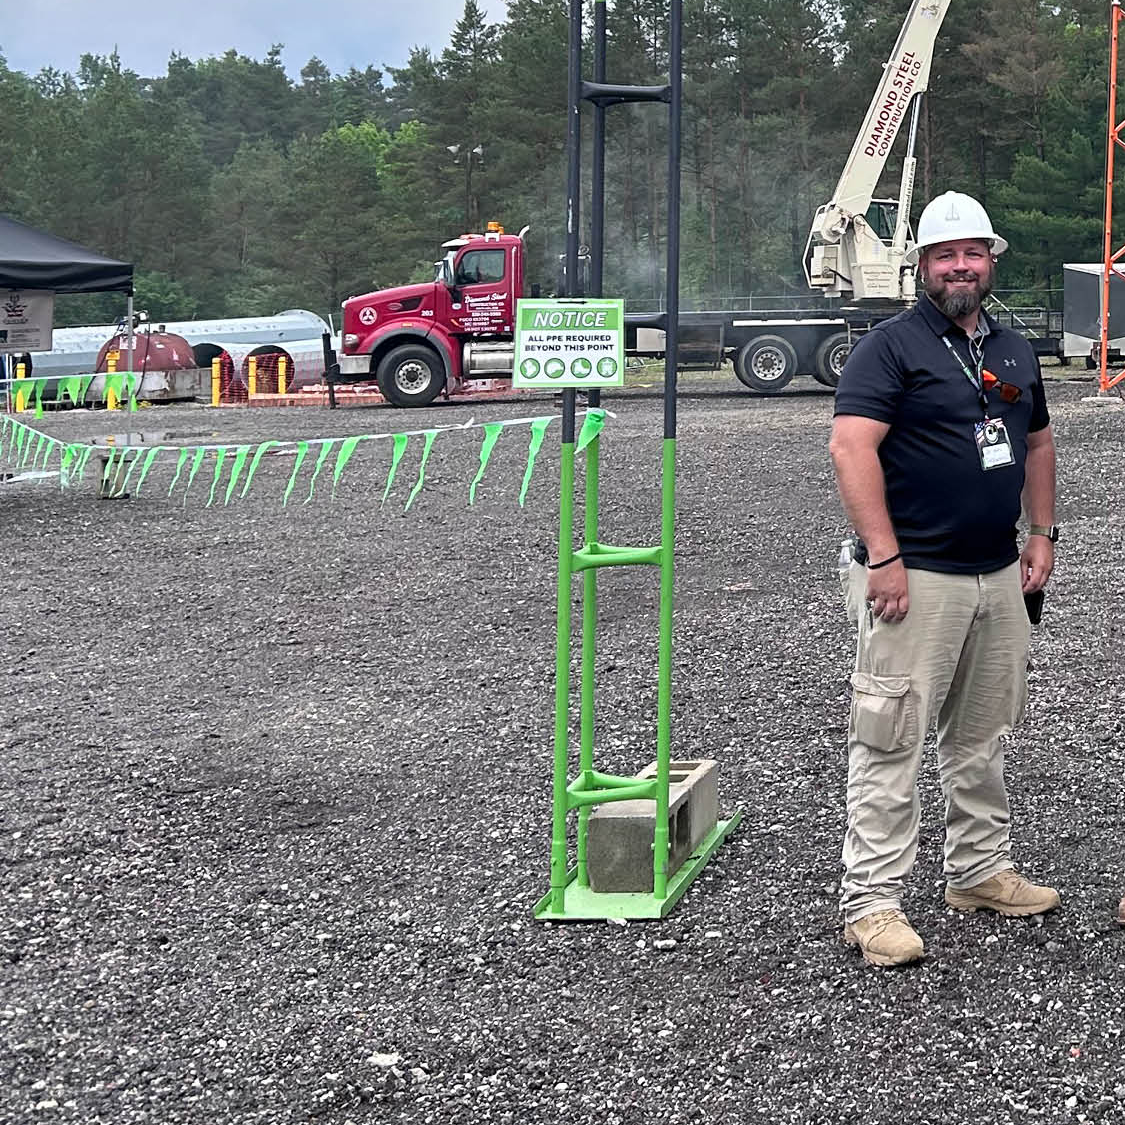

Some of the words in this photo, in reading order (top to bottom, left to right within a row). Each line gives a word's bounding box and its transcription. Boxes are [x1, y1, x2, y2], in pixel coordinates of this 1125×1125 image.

[864, 91, 898, 157] DIAMOND
[893, 52, 915, 88] STEEL
[878, 78, 914, 157] CONSTRUCTION
[533, 311, 608, 327] NOTICE
